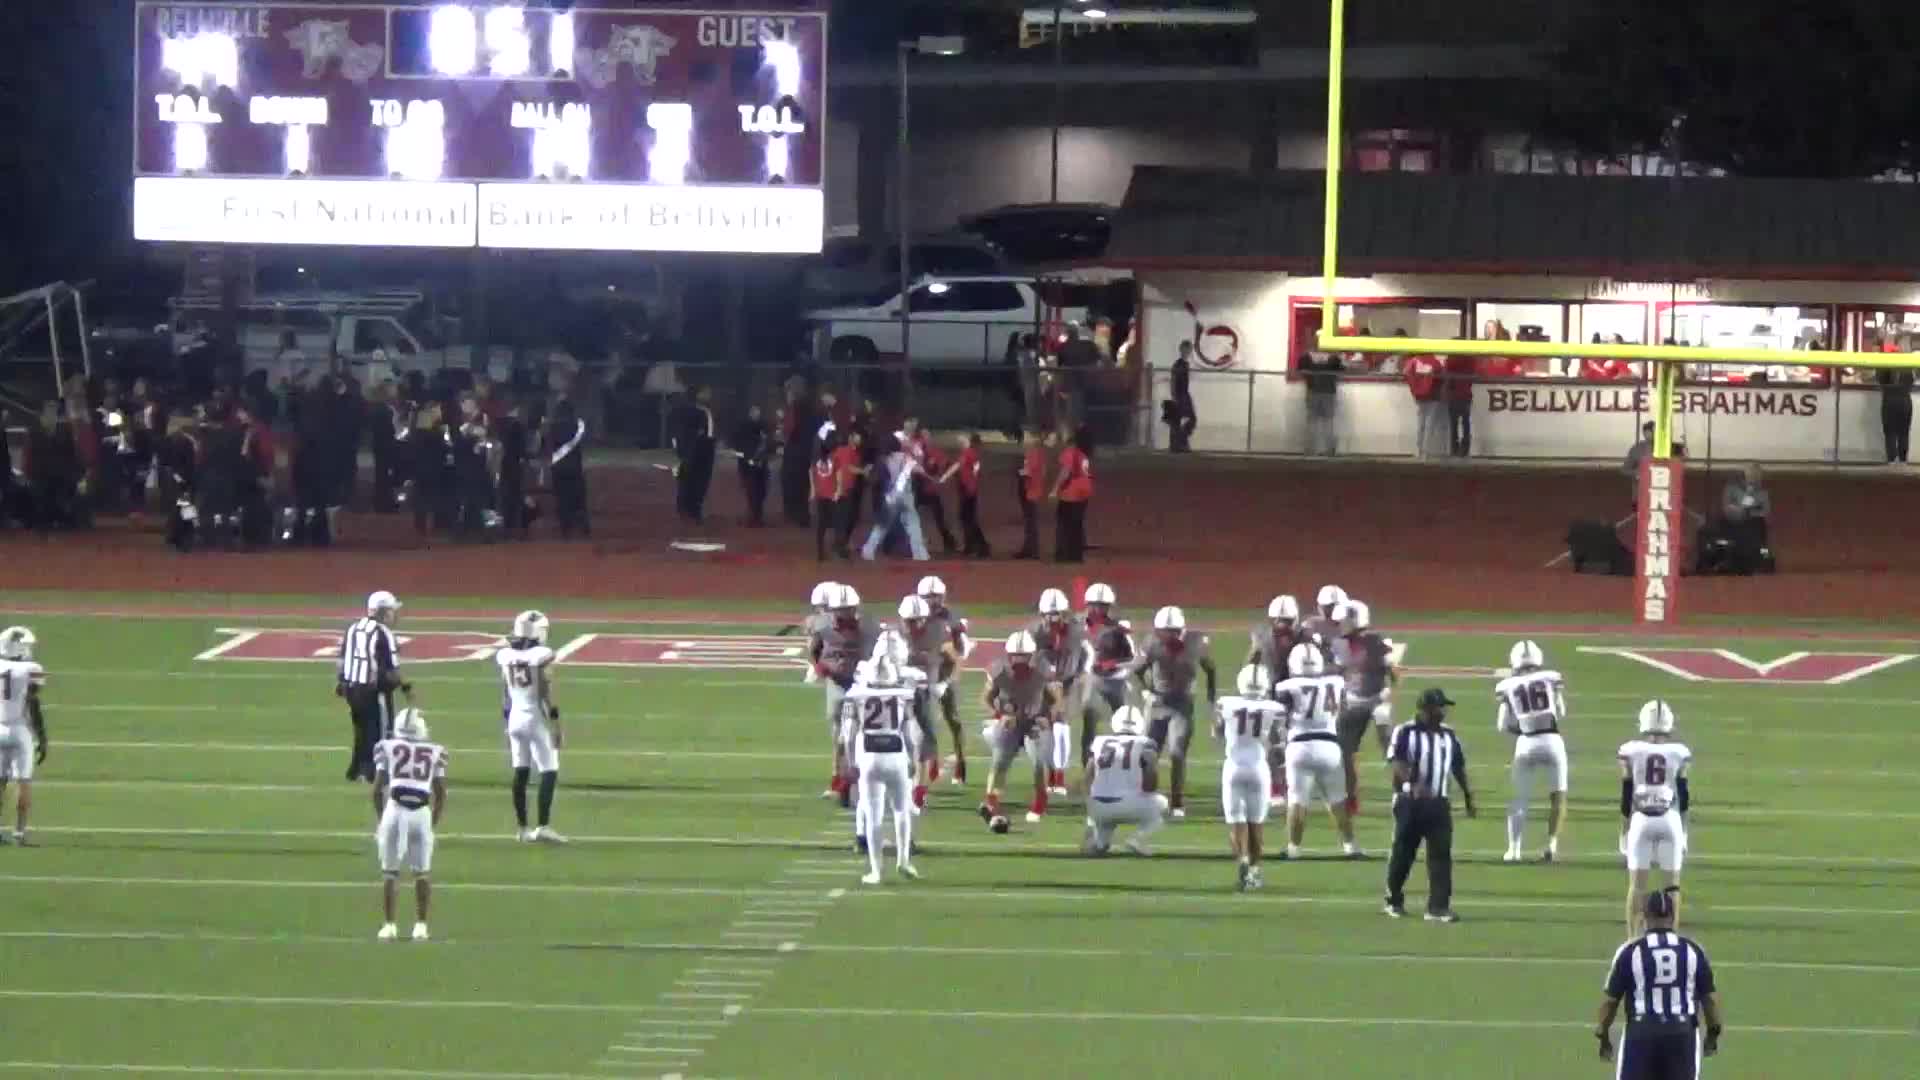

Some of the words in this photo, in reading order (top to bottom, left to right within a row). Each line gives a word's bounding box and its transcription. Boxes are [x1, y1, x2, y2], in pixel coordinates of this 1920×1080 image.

[697, 16, 794, 47] GUEST
[317, 199, 467, 226] National
[487, 201, 577, 227] Bank
[598, 202, 629, 227] of
[649, 202, 795, 229] Bellville
[1487, 389, 1649, 414] BELLVILLE
[1671, 390, 1818, 417] BRAHMAS
[1644, 466, 1672, 621] BRAHMAS
[864, 695, 898, 729] 21
[1299, 683, 1339, 720] 74
[1513, 681, 1551, 713] 16
[1233, 707, 1264, 738] 11
[392, 744, 433, 782] 25
[1097, 739, 1135, 770] 51
[1645, 753, 1667, 785] 6
[1652, 949, 1677, 984] B
